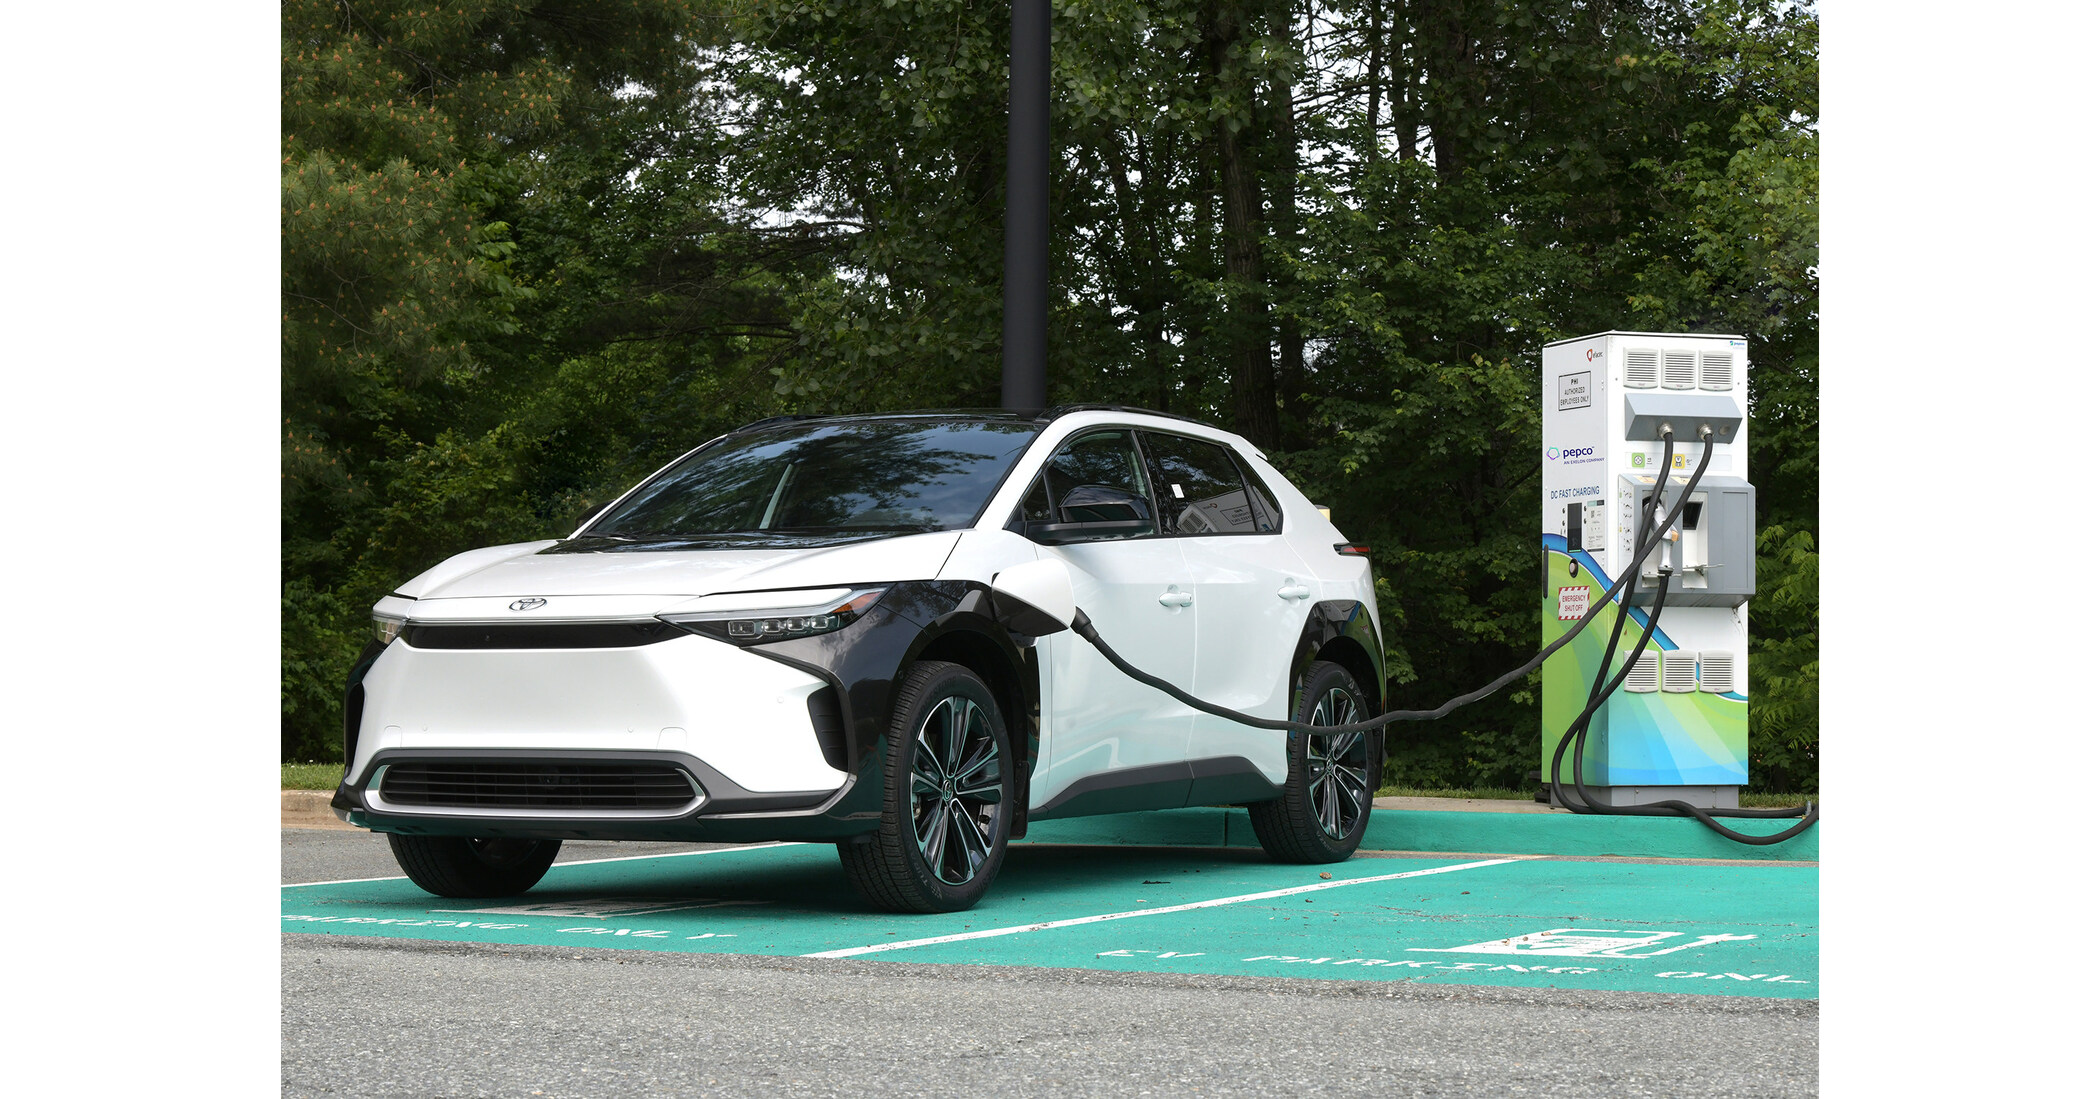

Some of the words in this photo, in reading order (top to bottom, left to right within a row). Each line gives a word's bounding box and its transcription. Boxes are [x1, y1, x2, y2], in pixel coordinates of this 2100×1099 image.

[1564, 386, 1585, 395] AUTHORIZED
[1560, 397, 1580, 406] EMPLOYEES
[1580, 395, 1589, 403] ONLY
[1563, 447, 1593, 459] pepco
[1551, 489, 1559, 500] DC
[1559, 488, 1572, 499] FAST
[1573, 486, 1600, 497] CHARGING
[1562, 594, 1586, 602] EMERGENCY
[1096, 949, 1205, 958] EV
[1241, 955, 1598, 974] PARKING
